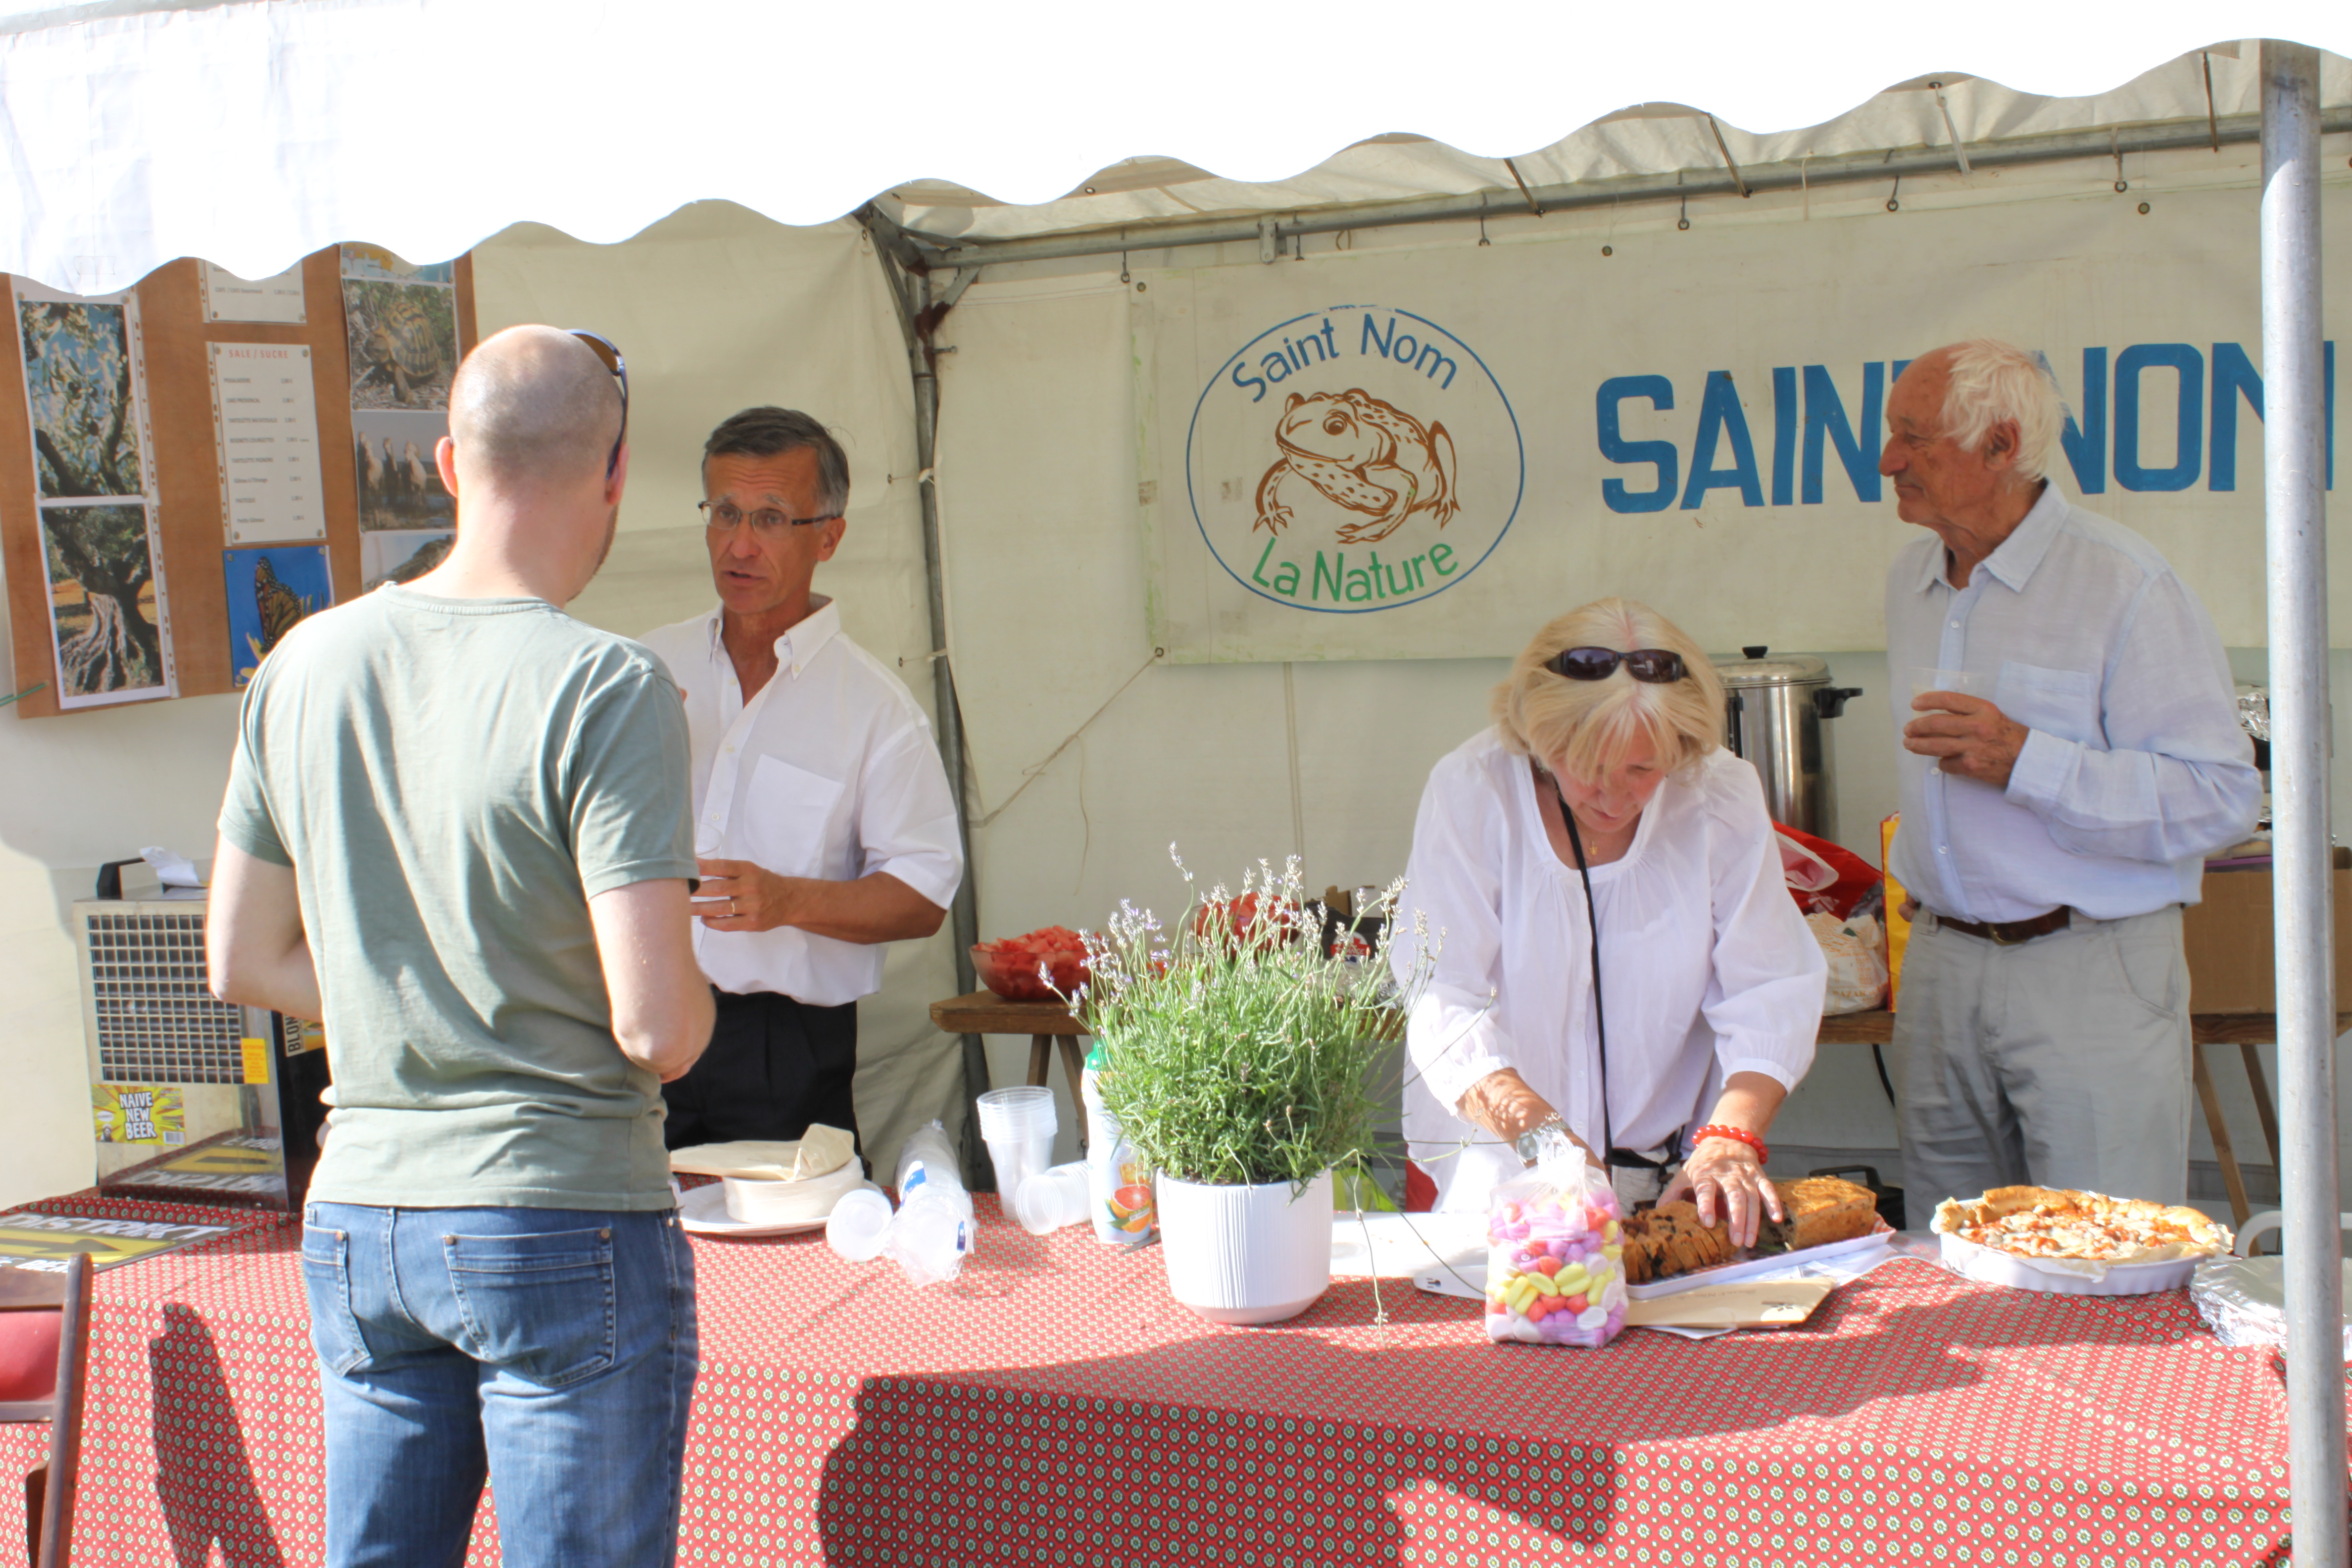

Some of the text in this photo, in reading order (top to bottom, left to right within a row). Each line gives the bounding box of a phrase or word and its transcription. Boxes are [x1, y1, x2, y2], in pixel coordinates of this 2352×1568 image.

[260, 350, 289, 359] SUCRE
[1231, 313, 1458, 402] Saint Nom
[1596, 361, 1914, 514] SAIN
[1252, 537, 1458, 602] La Nature
[119, 1091, 153, 1109] NAIVE
[126, 1107, 150, 1123] NEW
[125, 1121, 157, 1140] BEER
